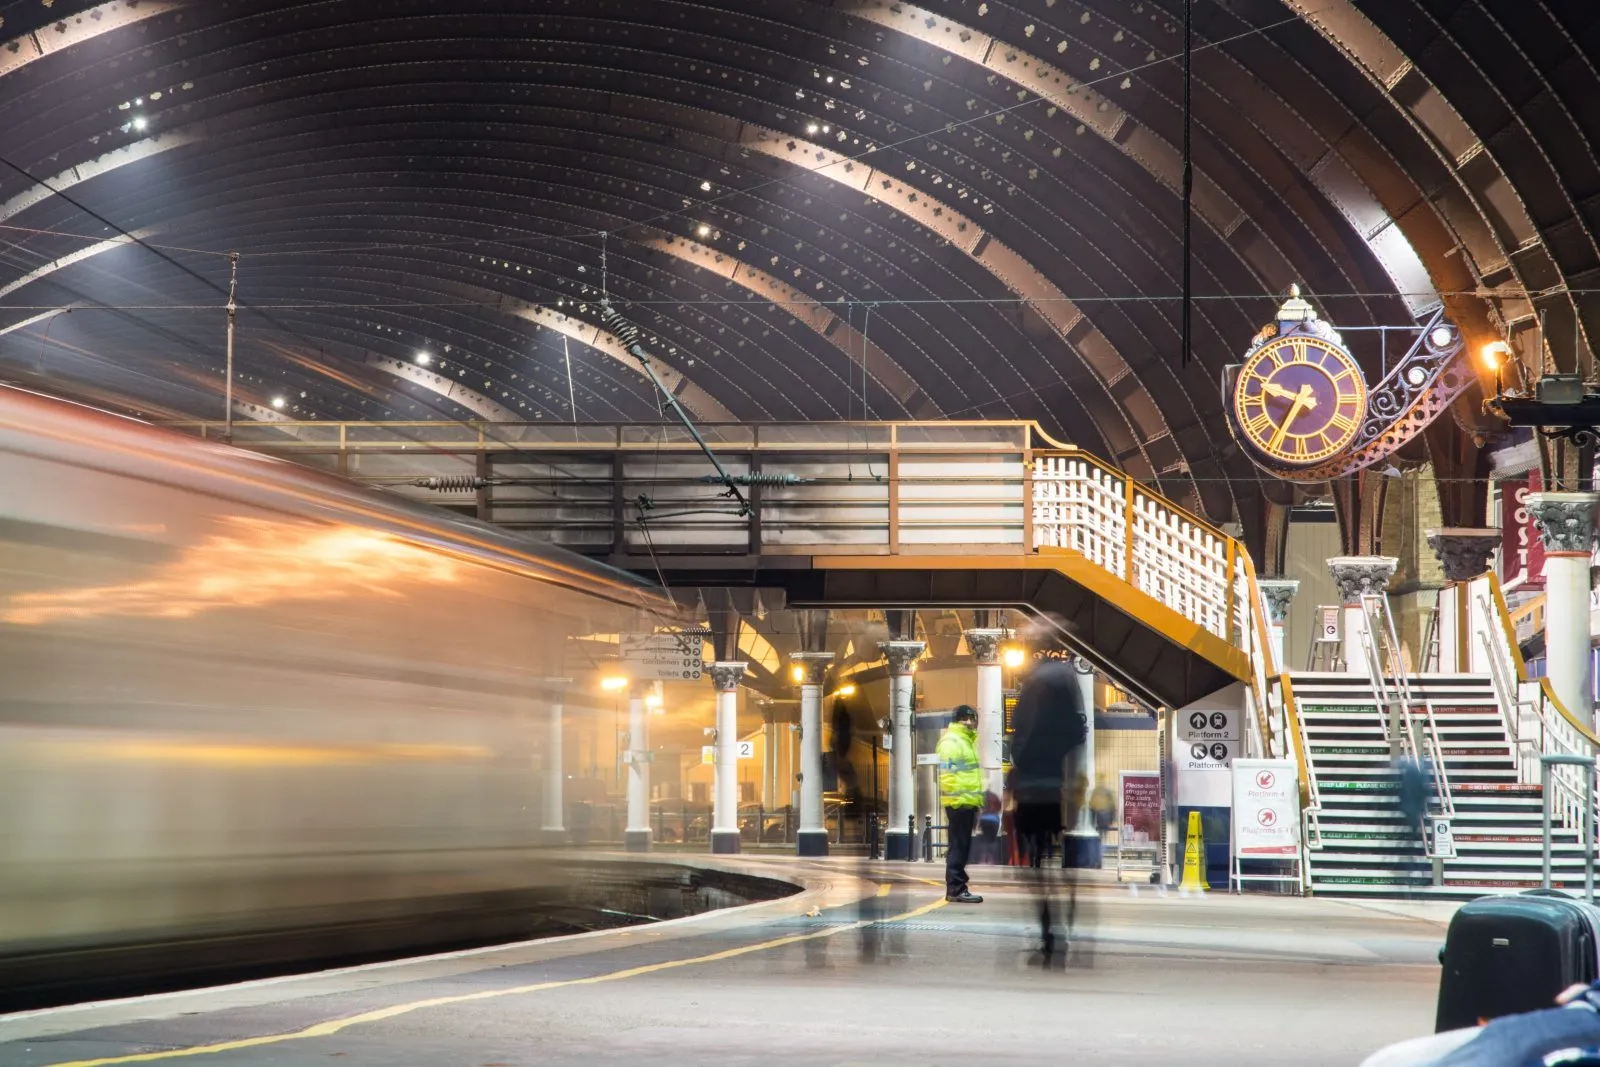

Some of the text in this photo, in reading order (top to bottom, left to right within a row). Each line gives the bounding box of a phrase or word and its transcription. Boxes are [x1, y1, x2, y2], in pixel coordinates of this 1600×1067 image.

[1267, 348, 1284, 368] XI
[1292, 343, 1306, 362] XII
[1332, 368, 1352, 381] II
[1244, 394, 1262, 406] IX
[1338, 394, 1358, 404] III
[1250, 413, 1271, 434] VIII
[1296, 438, 1307, 455] VI
[740, 743, 749, 756] 2
[1188, 761, 1222, 769] Platform
